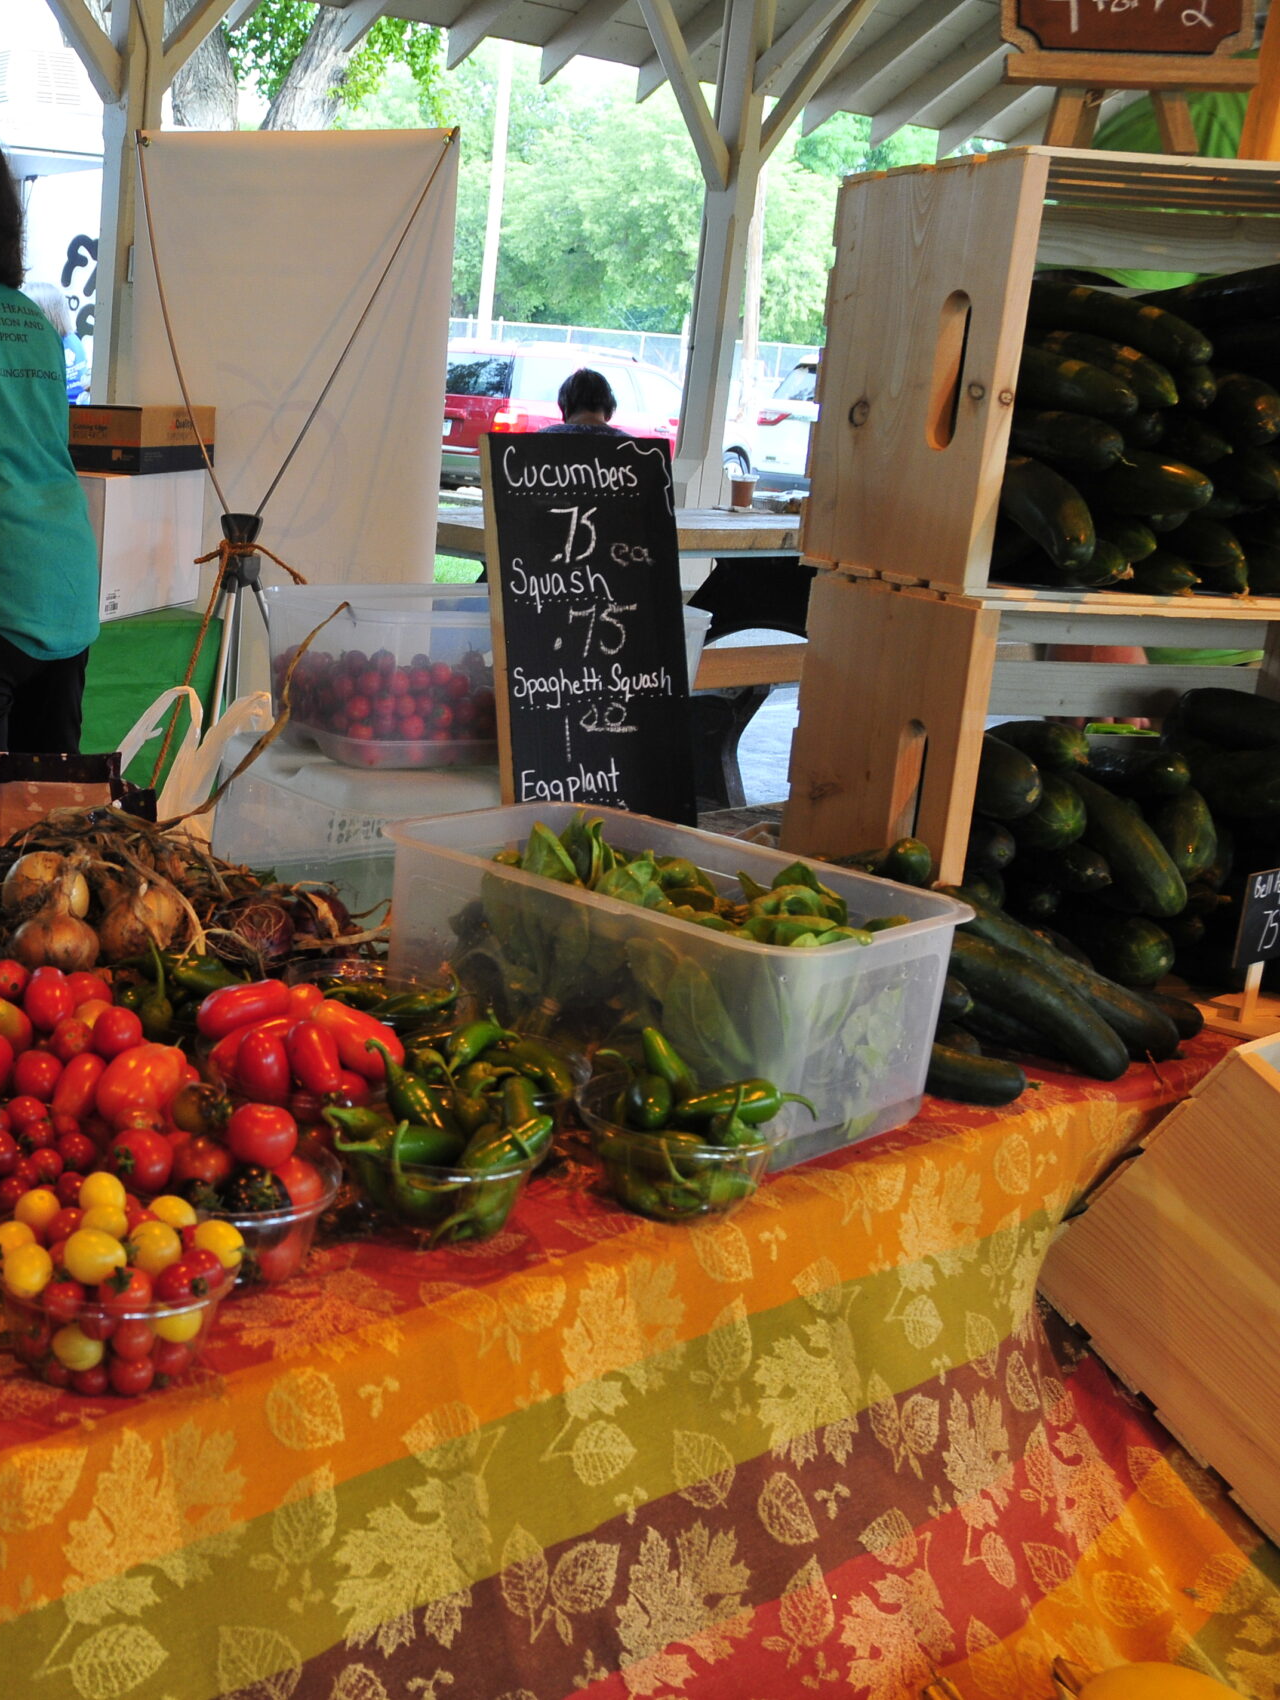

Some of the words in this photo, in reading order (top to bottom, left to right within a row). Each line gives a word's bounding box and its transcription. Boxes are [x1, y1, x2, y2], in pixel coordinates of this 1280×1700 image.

[503, 446, 638, 490] Cucumbers
[510, 558, 615, 614] Squash
[553, 602, 638, 659] .75
[513, 666, 604, 709] Spaghetti
[608, 662, 673, 703] Squash
[521, 757, 621, 802] Eggplant
